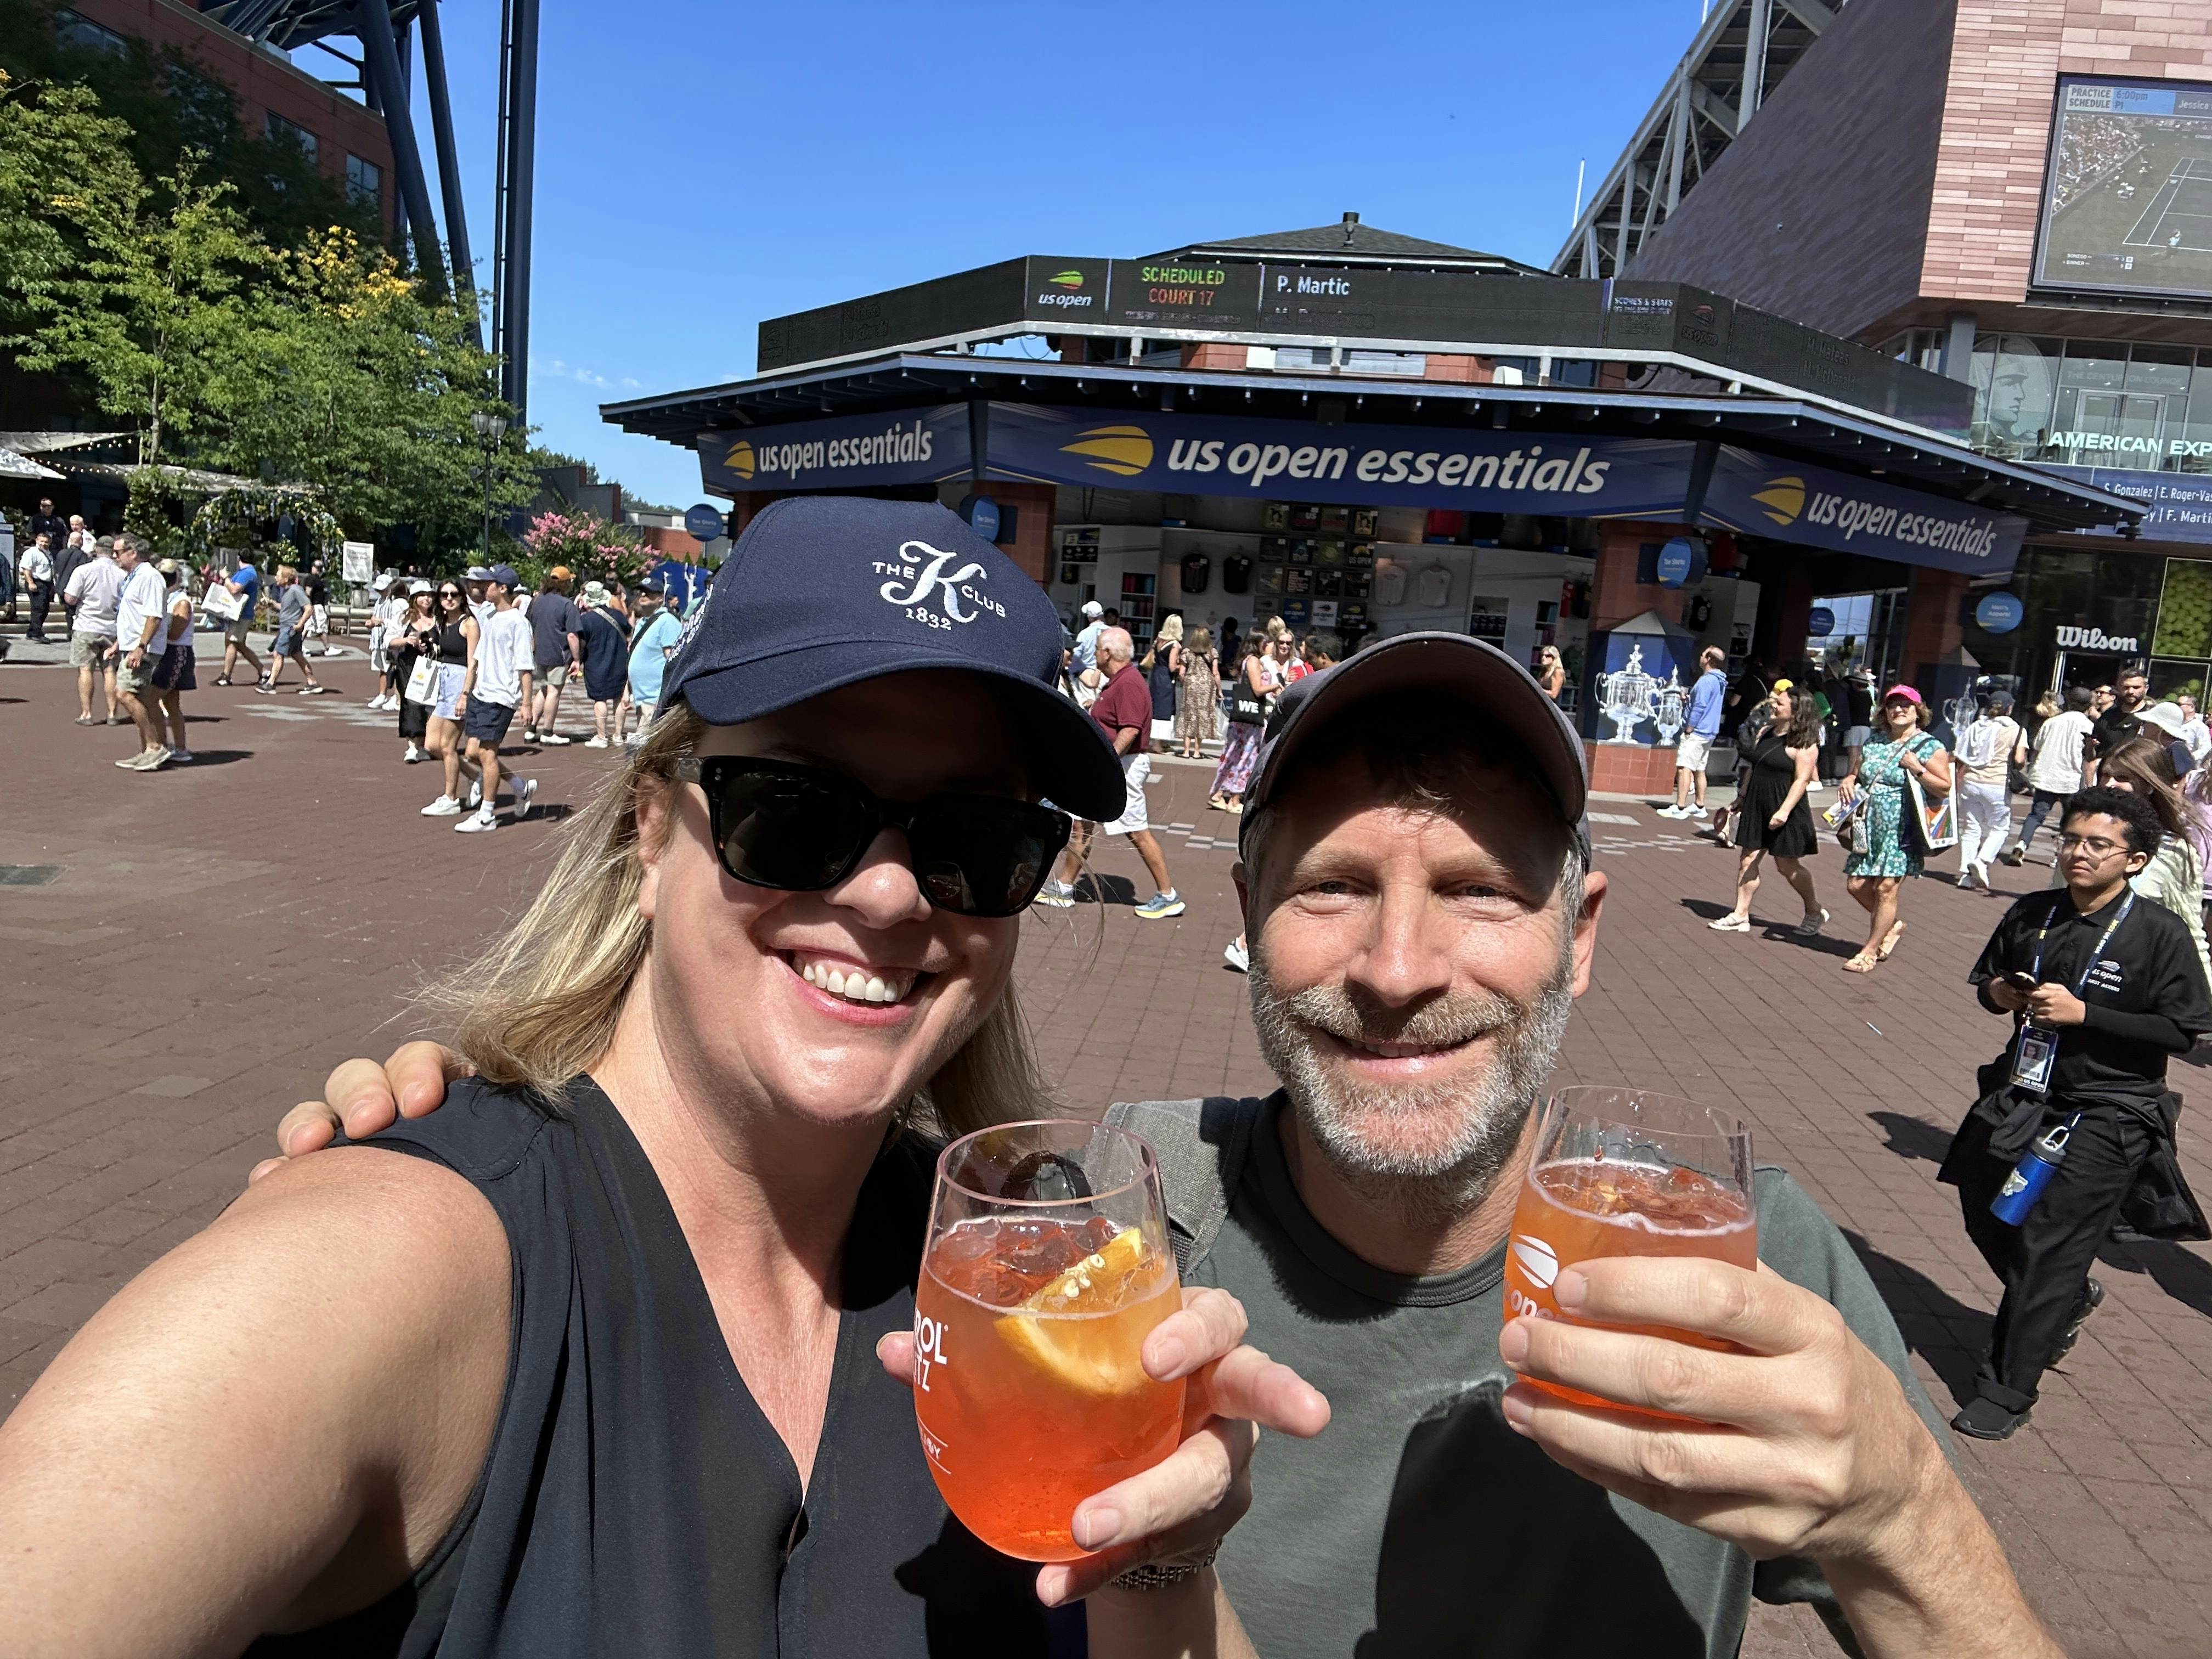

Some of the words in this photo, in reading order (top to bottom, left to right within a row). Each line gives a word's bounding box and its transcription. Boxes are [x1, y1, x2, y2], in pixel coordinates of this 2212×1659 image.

[2072, 88, 2112, 98] PRACTICE
[2116, 90, 2148, 101] 6:00pm
[2069, 98, 2111, 109] SCHEDULE
[2178, 100, 2209, 110] Jessica
[1142, 266, 1226, 285] SCHEDULED
[1277, 275, 1293, 293] P.
[1297, 276, 1351, 296] Martic
[1038, 293, 1056, 306] us
[1056, 294, 1092, 307] open
[1148, 288, 1195, 305] COURT
[1199, 290, 1214, 306] 17
[759, 445, 779, 473] us
[780, 440, 825, 480] open
[828, 419, 933, 467] essentials
[2047, 432, 2163, 453] AMERICAN
[2169, 441, 2212, 456] EXP
[1167, 438, 1223, 472] us
[1227, 442, 1351, 487] open
[1357, 445, 1610, 494] essentials
[2115, 484, 2153, 498] Gonzalez
[2160, 487, 2168, 498] E.
[2166, 509, 2177, 521] F.
[1808, 493, 1842, 524] us
[1838, 499, 1897, 540] open
[1896, 512, 1997, 557] essentials
[872, 561, 916, 580] THE
[962, 585, 1006, 618] CLUB
[905, 607, 952, 630] 1832
[2056, 624, 2138, 652] Wilson
[1238, 699, 1259, 713] WE
[2100, 970, 2123, 983] open
